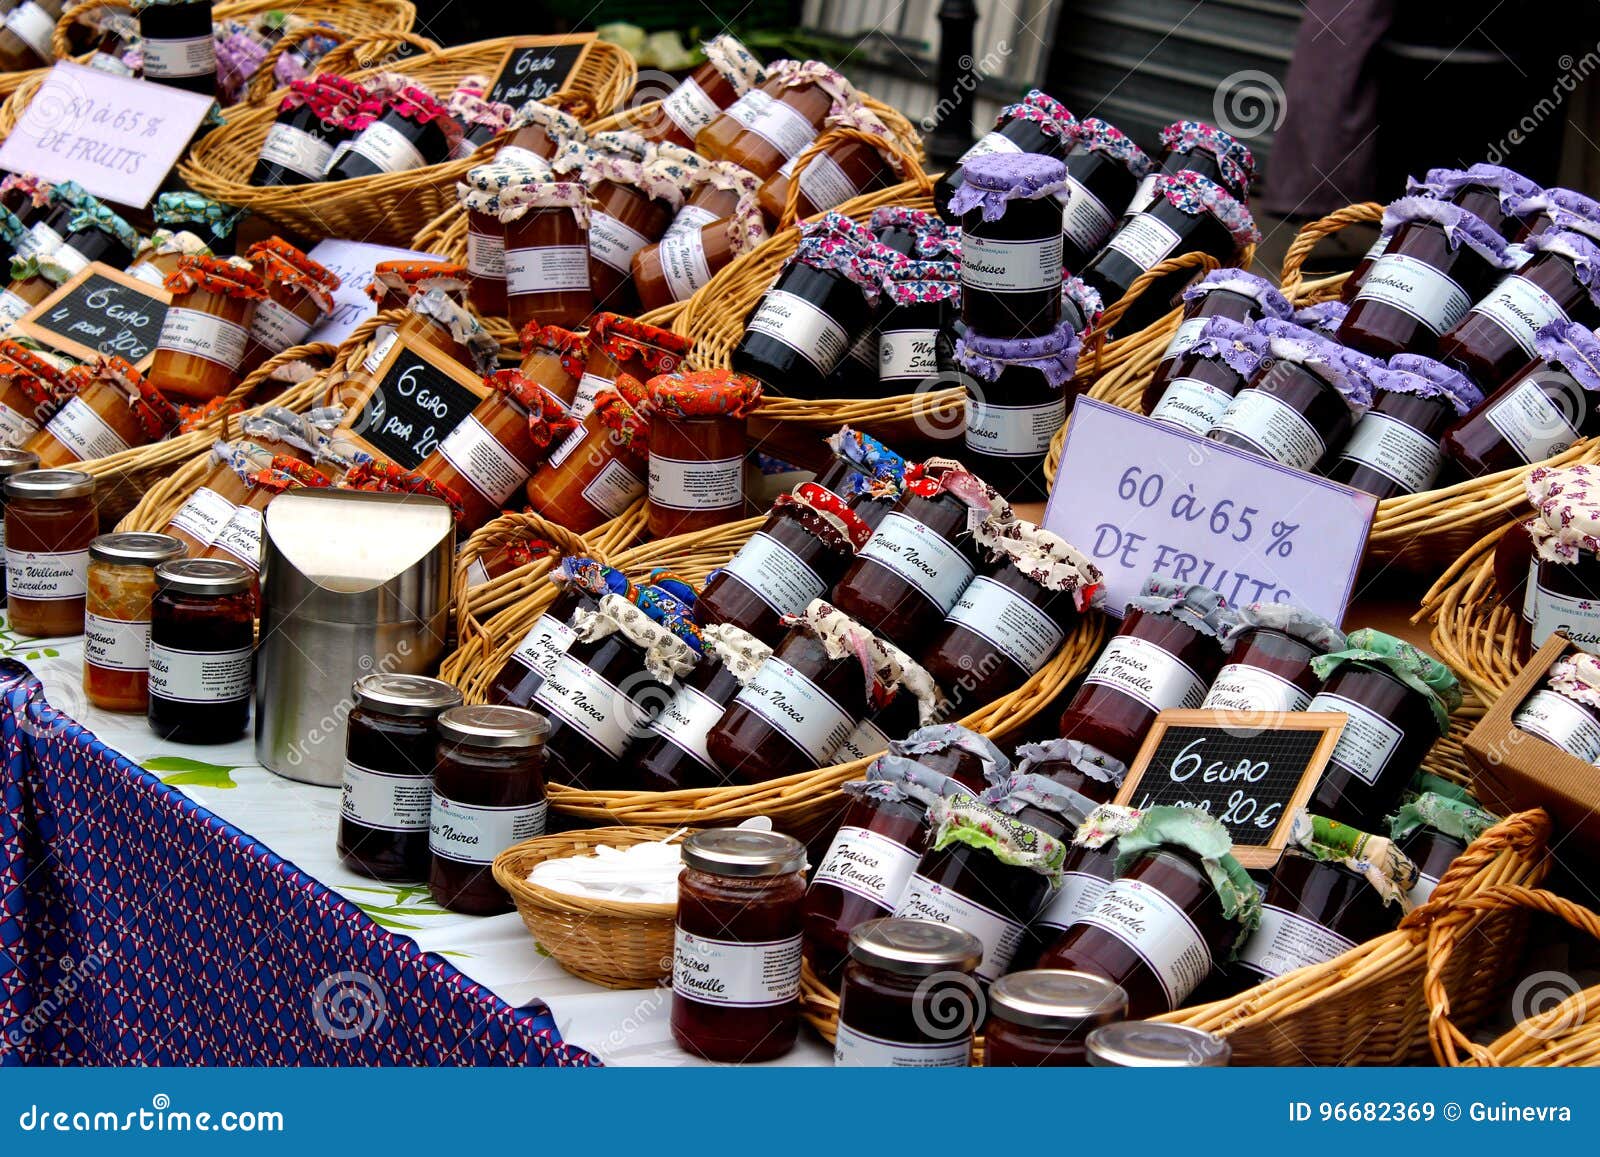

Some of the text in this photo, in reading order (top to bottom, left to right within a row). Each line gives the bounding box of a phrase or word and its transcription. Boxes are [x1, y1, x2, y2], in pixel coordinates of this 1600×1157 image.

[515, 50, 534, 75] 6
[493, 84, 502, 101] 4
[113, 107, 139, 132] 65
[37, 128, 147, 175] DE FRUITS
[86, 288, 118, 309] 6
[1499, 293, 1541, 332] Frambois
[397, 364, 448, 419] 6 EURO
[370, 400, 385, 426] 4
[1118, 466, 1299, 557] 60 à 65 %
[870, 533, 938, 578] Figues Noires
[1092, 523, 1146, 569] DE
[11, 578, 58, 592] Speculoos
[25, 567, 74, 577] Williams
[1105, 650, 1148, 671] Fraises
[1111, 666, 1153, 691] Vanille
[571, 690, 605, 723] Noires
[769, 690, 804, 724] Noires
[1170, 738, 1270, 783] 6 EURO
[442, 825, 479, 845] Noires
[836, 844, 879, 869] Fraises
[838, 862, 887, 892] Vanille
[907, 893, 951, 923] Fraises
[1099, 903, 1146, 934] Menthe
[681, 970, 726, 993] Vanille
